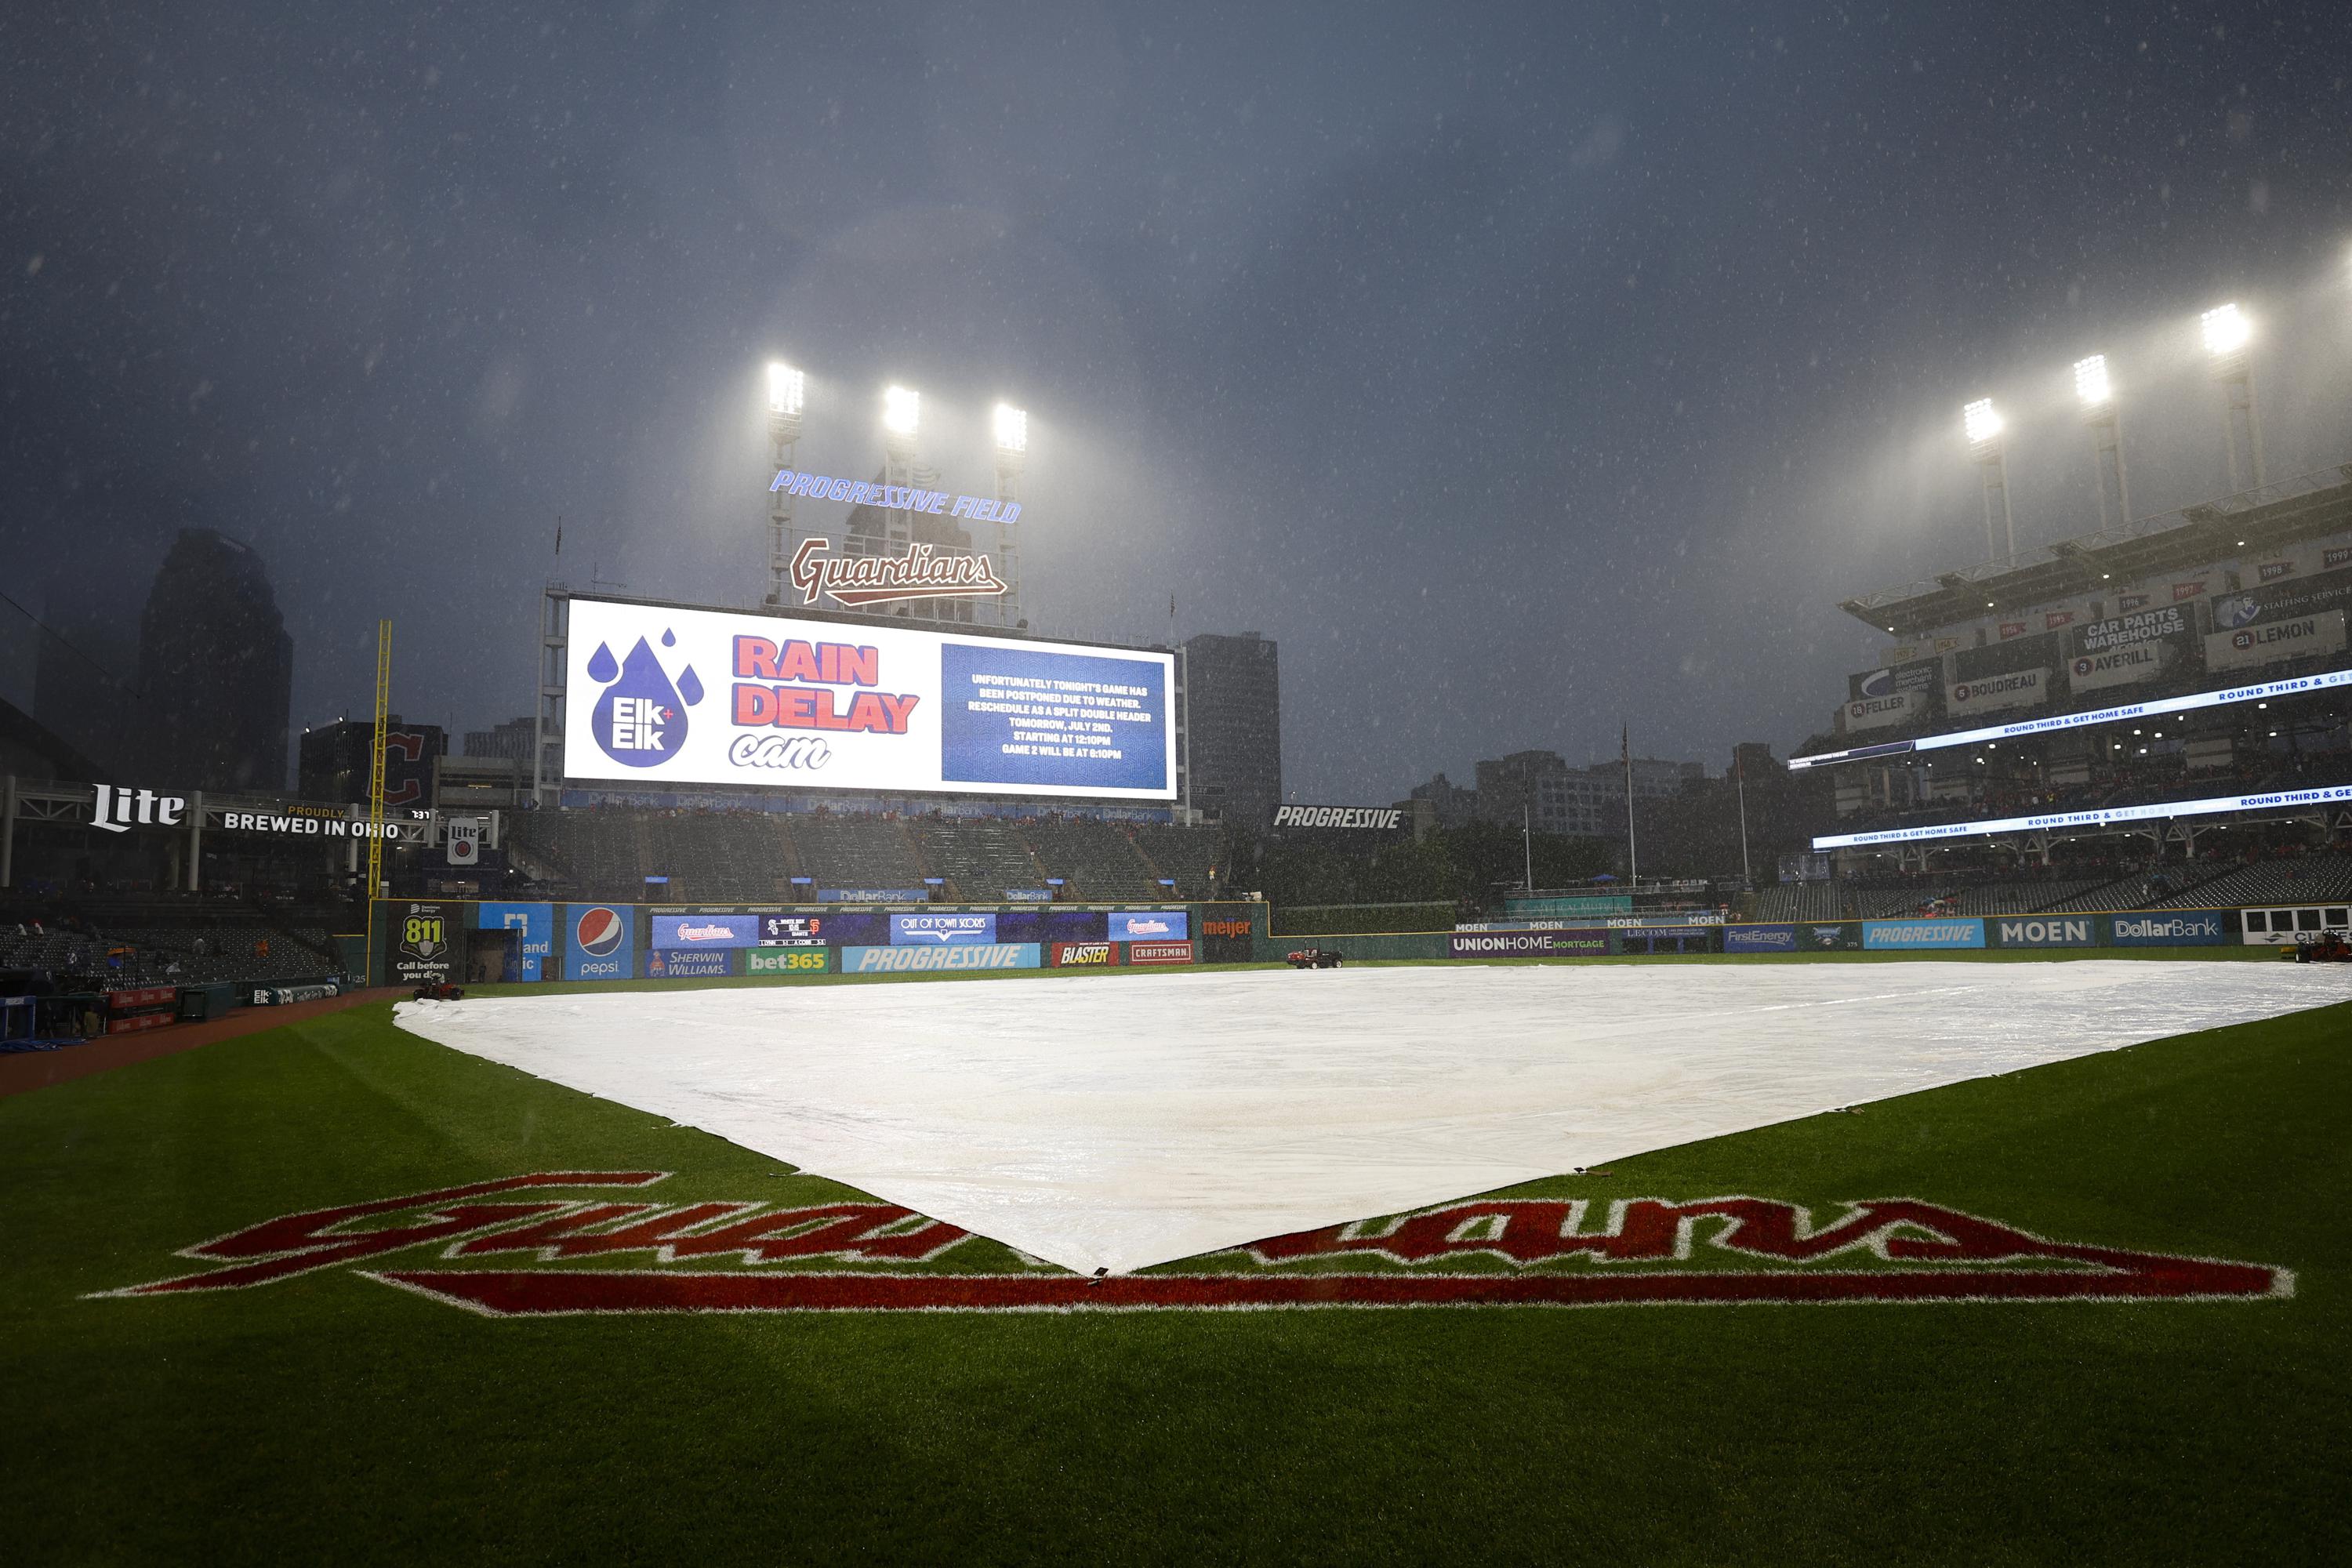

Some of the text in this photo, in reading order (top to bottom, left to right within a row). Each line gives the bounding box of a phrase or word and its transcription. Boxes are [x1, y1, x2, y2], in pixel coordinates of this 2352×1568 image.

[768, 470, 1022, 524] PROGRESSIVE FIELD
[2327, 550, 2348, 563] 1999
[789, 538, 1008, 606] Guardians
[2263, 565, 2282, 577] 1998
[2176, 585, 2194, 596] 1997
[2122, 597, 2140, 608] 1996
[2263, 594, 2309, 611] STAFFING
[2087, 608, 2179, 637] CAR PARTS
[2083, 619, 2185, 650] WAREHOUSE
[2236, 620, 2314, 646] 21 LEMON
[732, 634, 879, 686] RAIN
[2080, 648, 2153, 672] 3 AVERILL
[1894, 666, 1933, 681] electronic
[1895, 674, 1933, 688] merchant
[971, 674, 1148, 697] UNFORTUNATELY TONIGHT'S GAME HAS
[1971, 673, 2036, 698] BOUDREAU
[2219, 688, 2263, 701] ROUND
[2268, 680, 2308, 693] THIRD
[979, 688, 1141, 709] BEEN POSTPONED DUE TO WEATHER.
[1853, 697, 1904, 715] 18 FELLER
[731, 683, 920, 735] DELAY
[968, 701, 1151, 722] RESCHEDULE AS A SPLIT DOUBLE HEADER
[1009, 717, 1112, 732] TOMORROW, JULY 2ND.
[2004, 724, 2034, 734] ROUND
[2036, 719, 2062, 729] THIRD
[2073, 714, 2089, 724] GET
[2092, 710, 2119, 720] HOME
[2121, 706, 2144, 716] SAFE
[612, 723, 665, 750] Elk
[1013, 731, 1110, 746] STARTING AT 12:10PM
[728, 734, 831, 771] cam
[1002, 744, 1029, 755] GAME
[1031, 746, 1038, 755] 2
[1039, 746, 1062, 757] WILL
[1063, 746, 1075, 757] BE
[1076, 747, 1088, 757] AT
[2241, 796, 2281, 806] ROUND
[2284, 792, 2319, 802] THIRD
[2335, 789, 2352, 797] GE
[88, 783, 185, 833] Lite
[288, 805, 345, 818] PROUDLY
[224, 812, 319, 835] BREWED
[324, 819, 346, 836] IN
[1273, 806, 1402, 829] PROGRESSIVE
[2028, 816, 2064, 826] ROUND
[2067, 813, 2100, 822] THIRD
[451, 826, 477, 840] Lite
[840, 891, 905, 902] DollarBank
[901, 917, 985, 928] OUT OF TOWN SCORES
[1127, 919, 1169, 935] Guardians
[1203, 919, 1251, 939] meijer
[1456, 924, 1488, 932] MOEN
[1530, 921, 1563, 930] MOEN
[1688, 916, 1725, 924] MOEN
[2115, 918, 2218, 938] DollarBank
[405, 918, 441, 945] 811
[677, 923, 735, 941] Guardians
[1728, 931, 1792, 943] FirstEnergy
[1868, 925, 1974, 942] PROGRESSIVE
[2002, 920, 2087, 942] MOEN
[1552, 940, 1604, 949] MORTGAGE
[670, 952, 724, 964] SHERWIN
[750, 953, 825, 971] bet365
[858, 946, 1022, 971] PROGRESSIVE
[1061, 946, 1110, 965] BLASTER
[397, 961, 449, 971] Call before
[581, 960, 618, 975] pepsi
[402, 971, 423, 981] you
